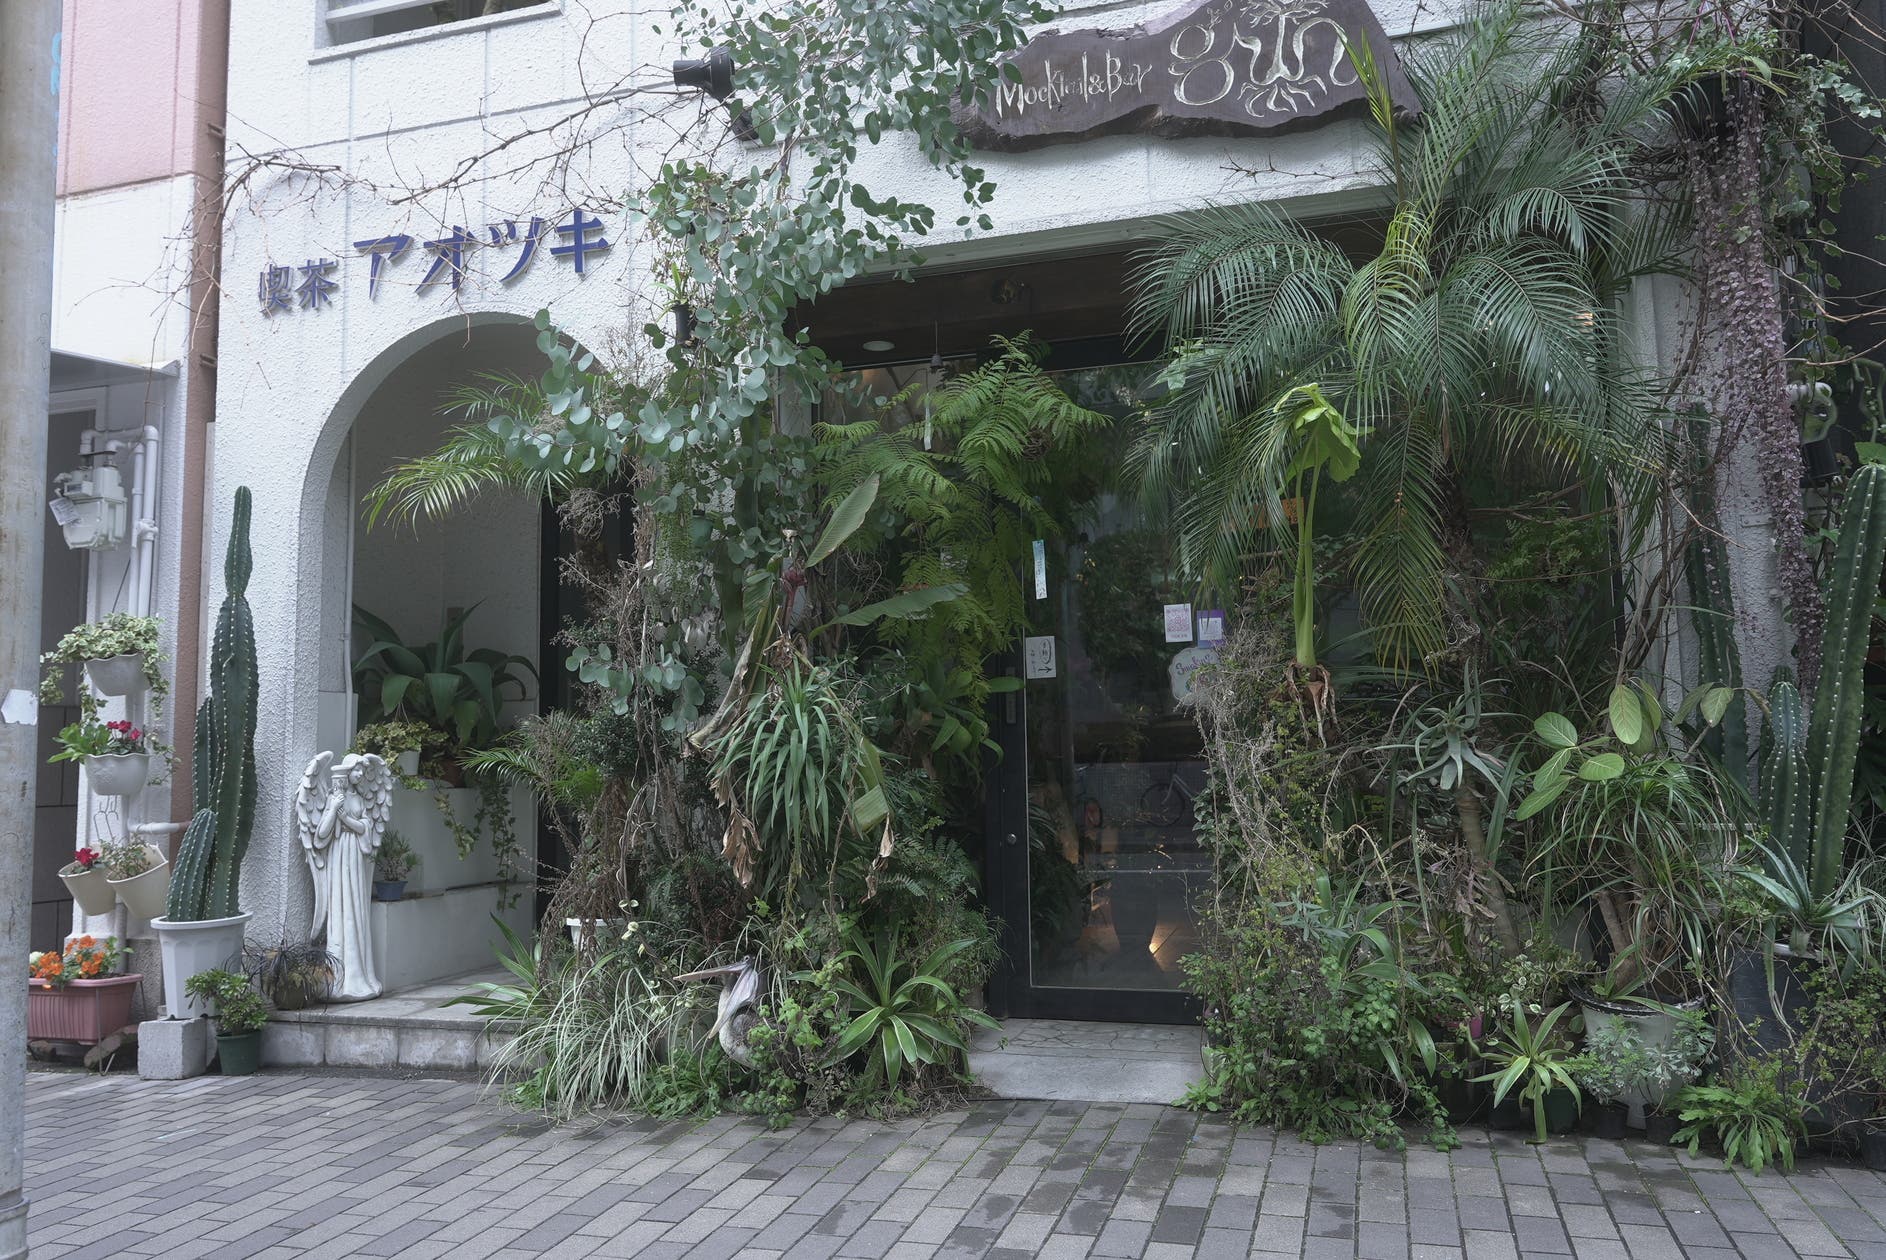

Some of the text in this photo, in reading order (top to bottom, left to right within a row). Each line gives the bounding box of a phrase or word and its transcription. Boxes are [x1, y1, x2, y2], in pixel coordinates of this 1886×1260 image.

[259, 207, 610, 315] 喫茶 アオツキ
